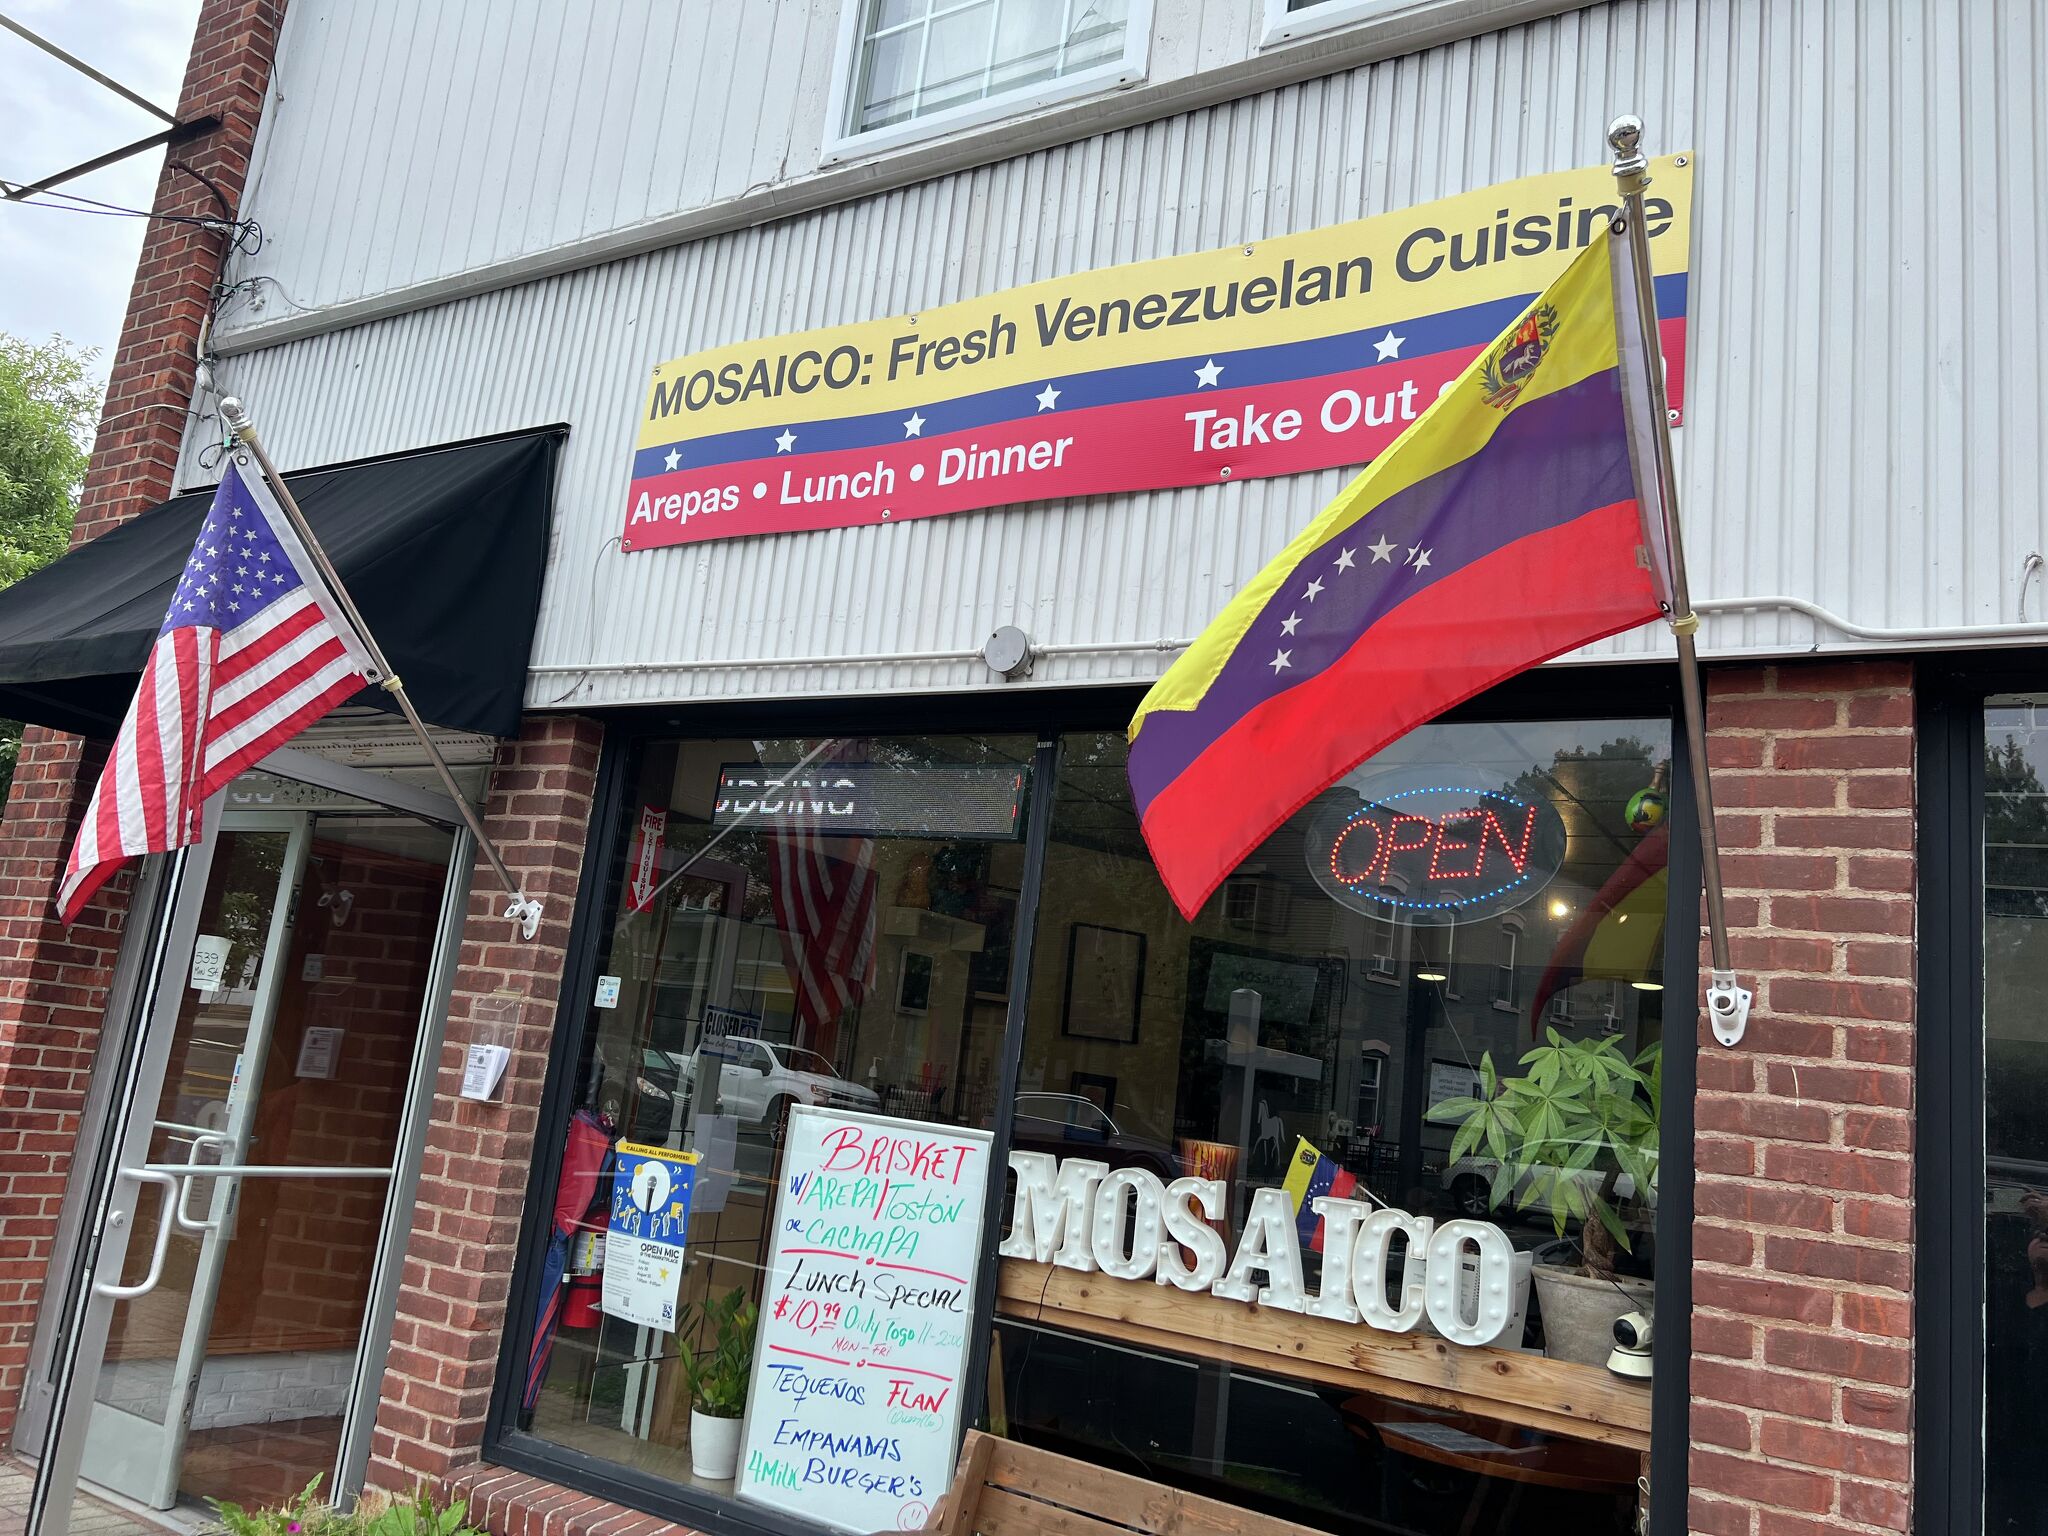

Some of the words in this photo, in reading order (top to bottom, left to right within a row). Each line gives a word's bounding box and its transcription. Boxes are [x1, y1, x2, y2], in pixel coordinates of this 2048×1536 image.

[649, 344, 874, 421] MOSAICO:
[886, 314, 1017, 382] Fresh
[1034, 255, 1374, 347] Venezuelan
[1184, 404, 1302, 452] Take
[1319, 380, 1419, 434] Out
[630, 481, 741, 529] Arepas
[779, 460, 895, 505] Lunch
[937, 436, 1074, 487] Dinner
[643, 815, 664, 831] FIRE
[1330, 805, 1538, 884] OPEN
[638, 832, 653, 901] EXTINGUISHER
[195, 951, 219, 965] 539
[704, 1011, 740, 1037] CLOSED
[626, 1145, 648, 1154] CALLING
[658, 1151, 690, 1161] PERFORMERS!
[820, 1126, 977, 1185] BRISKET
[640, 1242, 663, 1256] OPEN
[664, 1247, 680, 1259] MIC
[999, 1150, 1516, 1347] MOSAICO
[886, 1379, 950, 1414] FLAN
[773, 1418, 901, 1462] EMPANADAS
